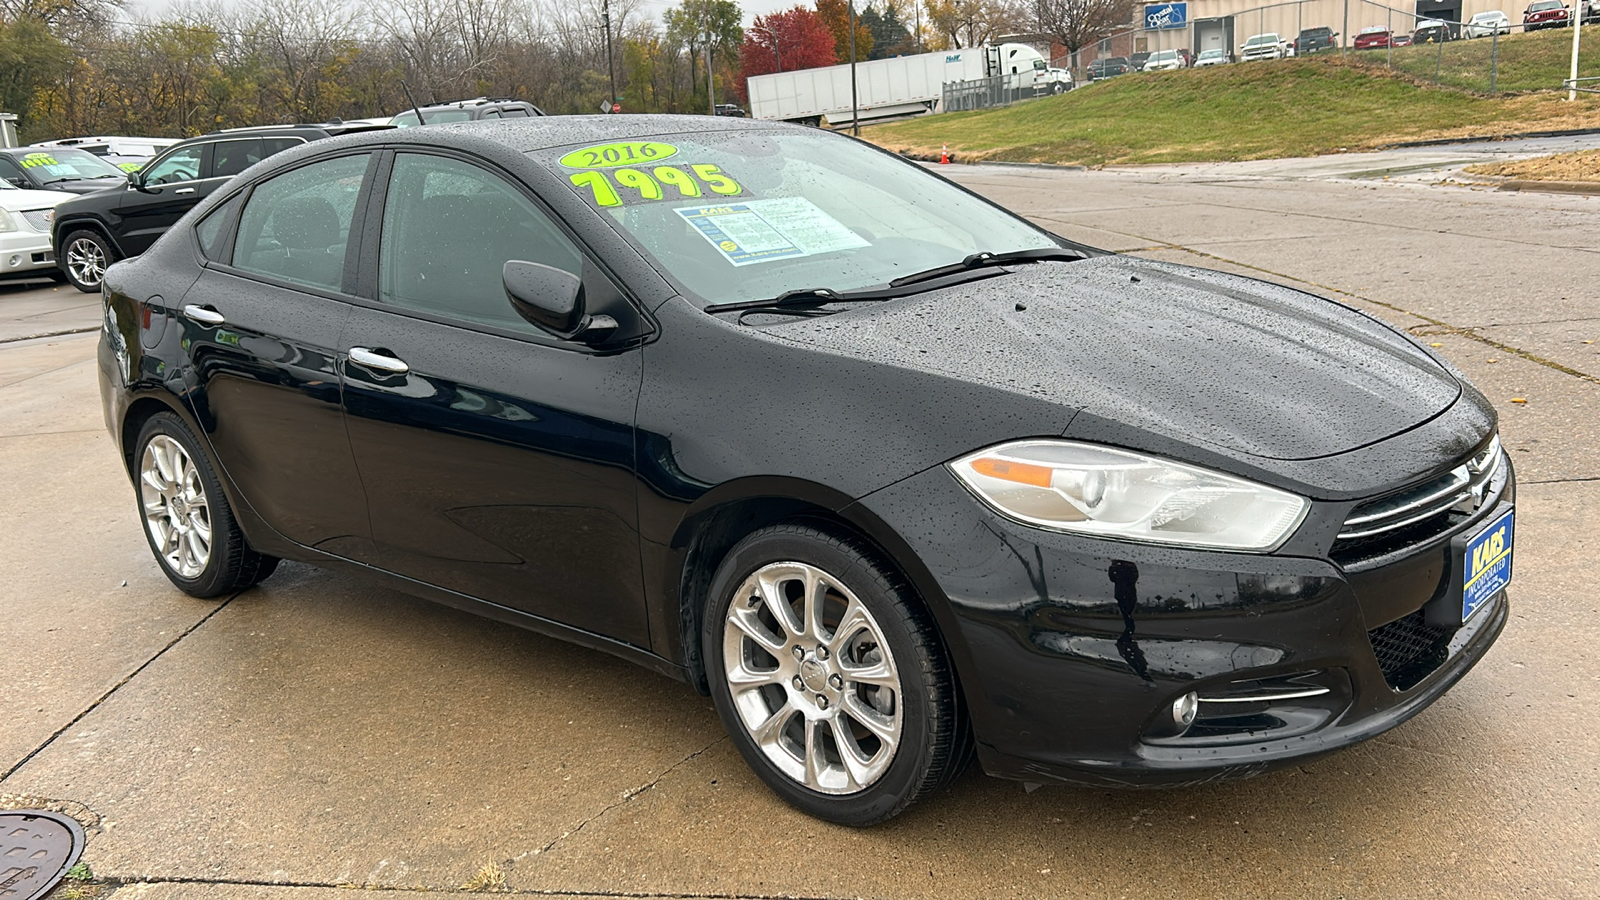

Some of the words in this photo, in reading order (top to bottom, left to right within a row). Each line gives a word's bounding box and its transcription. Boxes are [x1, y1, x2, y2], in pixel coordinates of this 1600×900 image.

[582, 143, 657, 166] 2016
[569, 163, 743, 207] 7995
[699, 206, 733, 215] KARS
[1471, 525, 1506, 578] KARS
[1468, 557, 1506, 598] INCORPORATED
